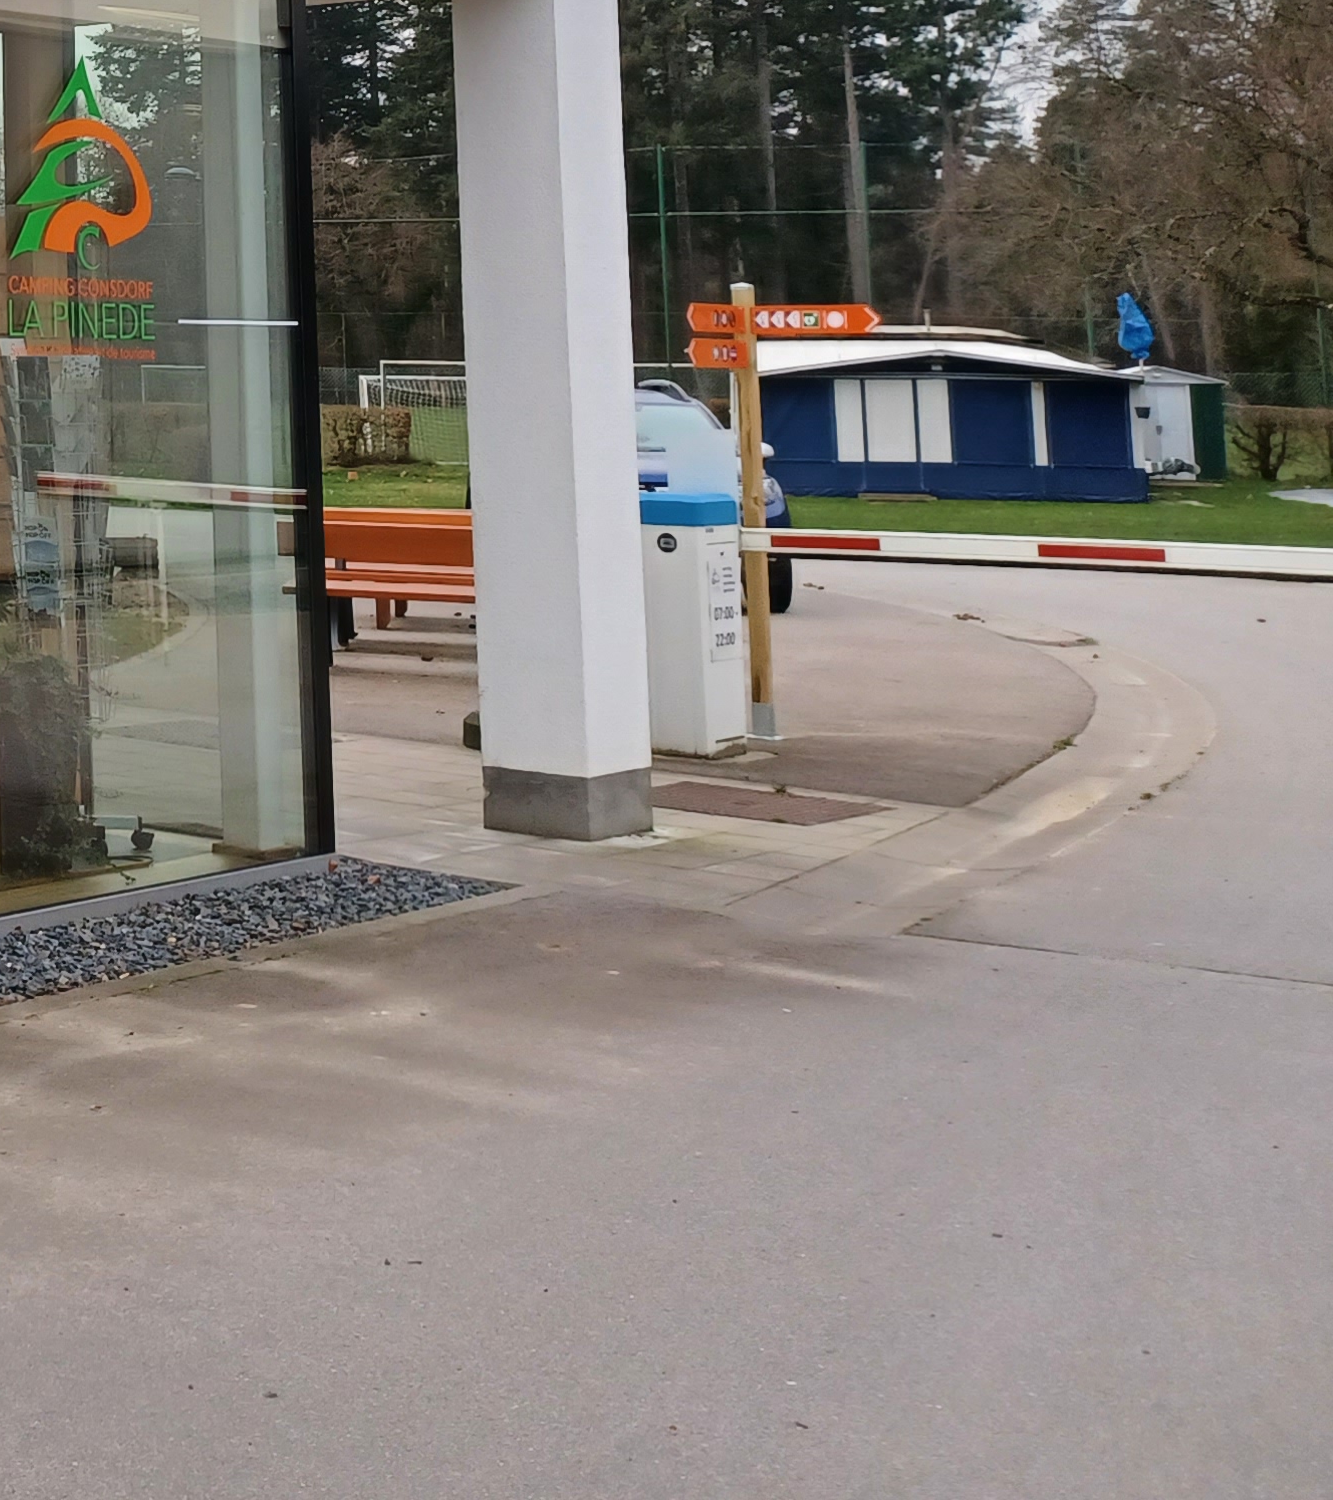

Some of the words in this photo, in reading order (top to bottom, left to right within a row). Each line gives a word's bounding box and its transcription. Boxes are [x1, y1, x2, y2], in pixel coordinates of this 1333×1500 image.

[8, 275, 75, 296] CAMPING
[78, 278, 154, 299] CONSDORF
[8, 299, 45, 338] LA
[52, 301, 156, 340] PINEDE
[715, 631, 735, 647] 22:00
